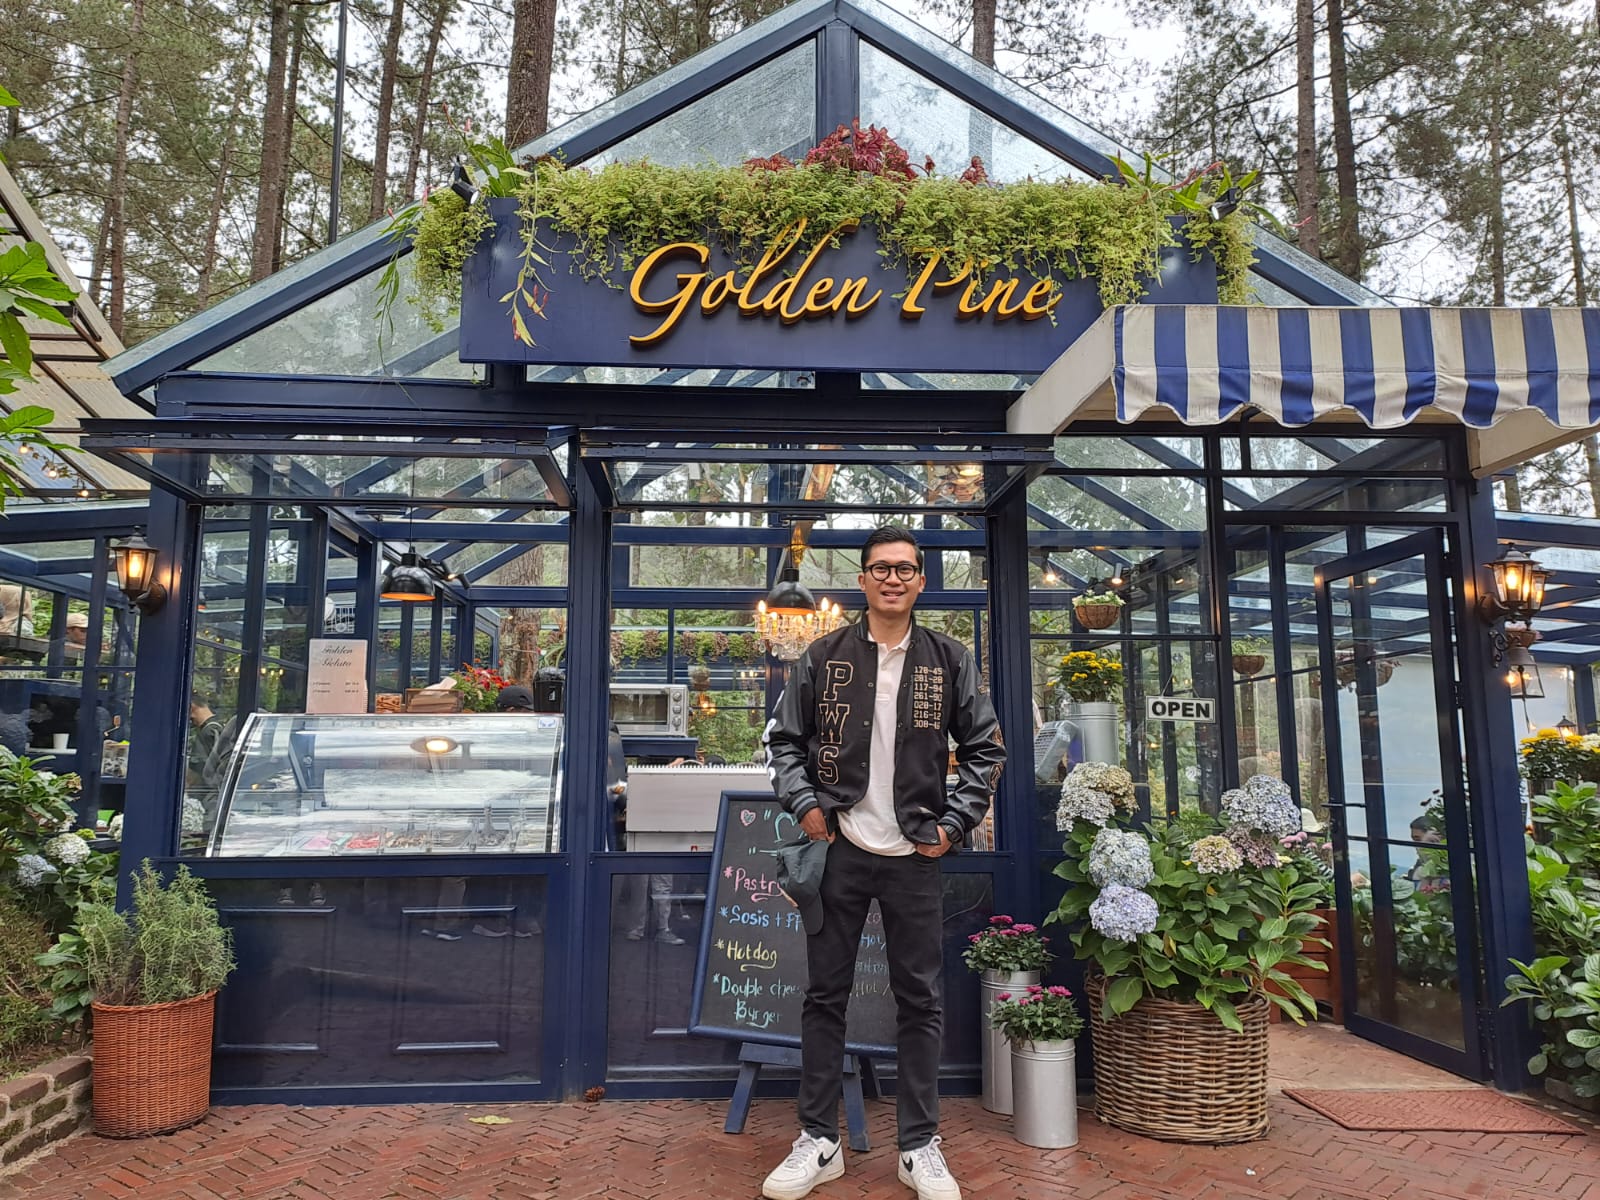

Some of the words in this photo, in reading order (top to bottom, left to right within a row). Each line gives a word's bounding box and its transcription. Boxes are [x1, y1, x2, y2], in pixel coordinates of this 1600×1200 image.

[629, 215, 882, 347] Golden
[902, 246, 1064, 321] Pine
[1151, 701, 1211, 718] OPEN
[729, 904, 770, 928] Sosis
[721, 975, 763, 998] Double
[734, 998, 781, 1029] Burger
